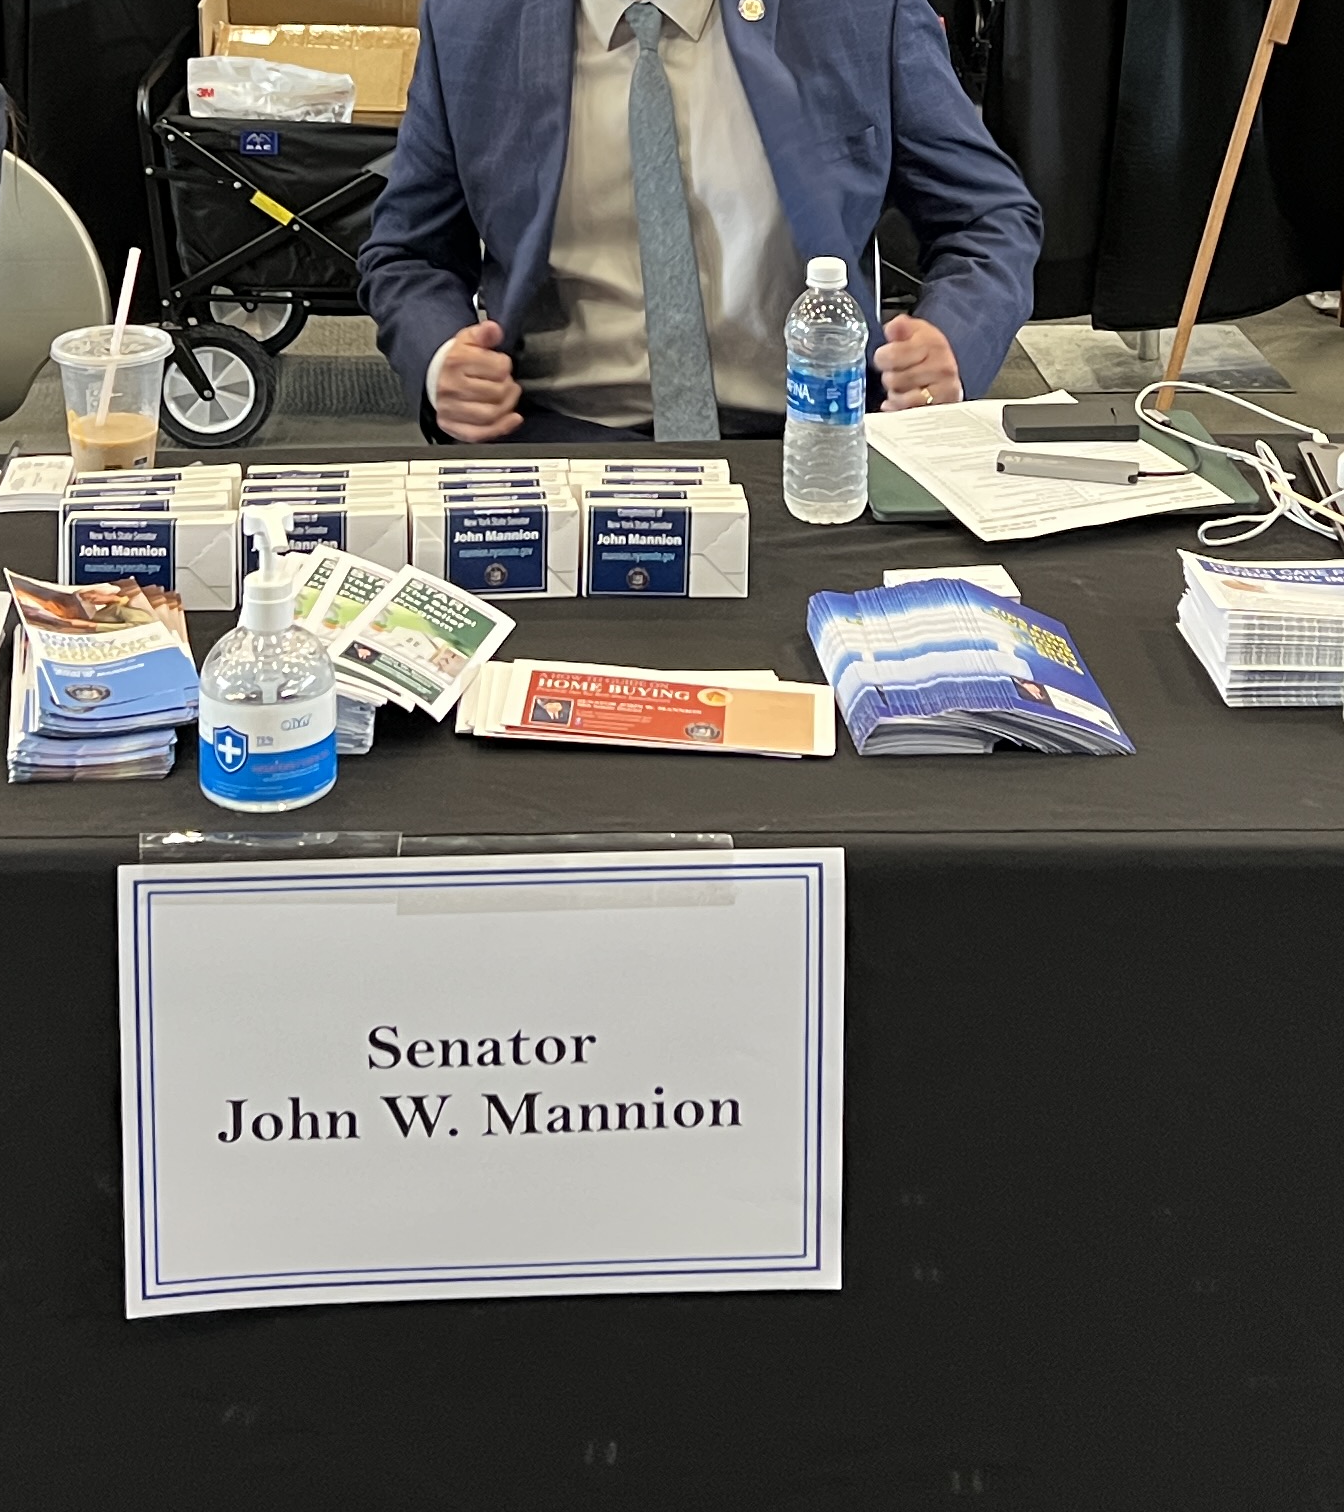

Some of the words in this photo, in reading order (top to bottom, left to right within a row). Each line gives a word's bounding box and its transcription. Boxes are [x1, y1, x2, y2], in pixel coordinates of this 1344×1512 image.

[197, 87, 215, 98] 3M
[454, 531, 483, 543] John
[485, 529, 539, 542] Mannion
[597, 533, 626, 545] John
[628, 533, 682, 546] Mannion
[79, 544, 110, 557] John
[111, 544, 167, 557] Mannion
[537, 678, 603, 694] HOME
[608, 684, 690, 701] BUYING
[366, 1023, 598, 1071] Senator
[216, 1096, 362, 1144] John
[380, 1094, 460, 1140] W.
[480, 1084, 745, 1137] Mannion
